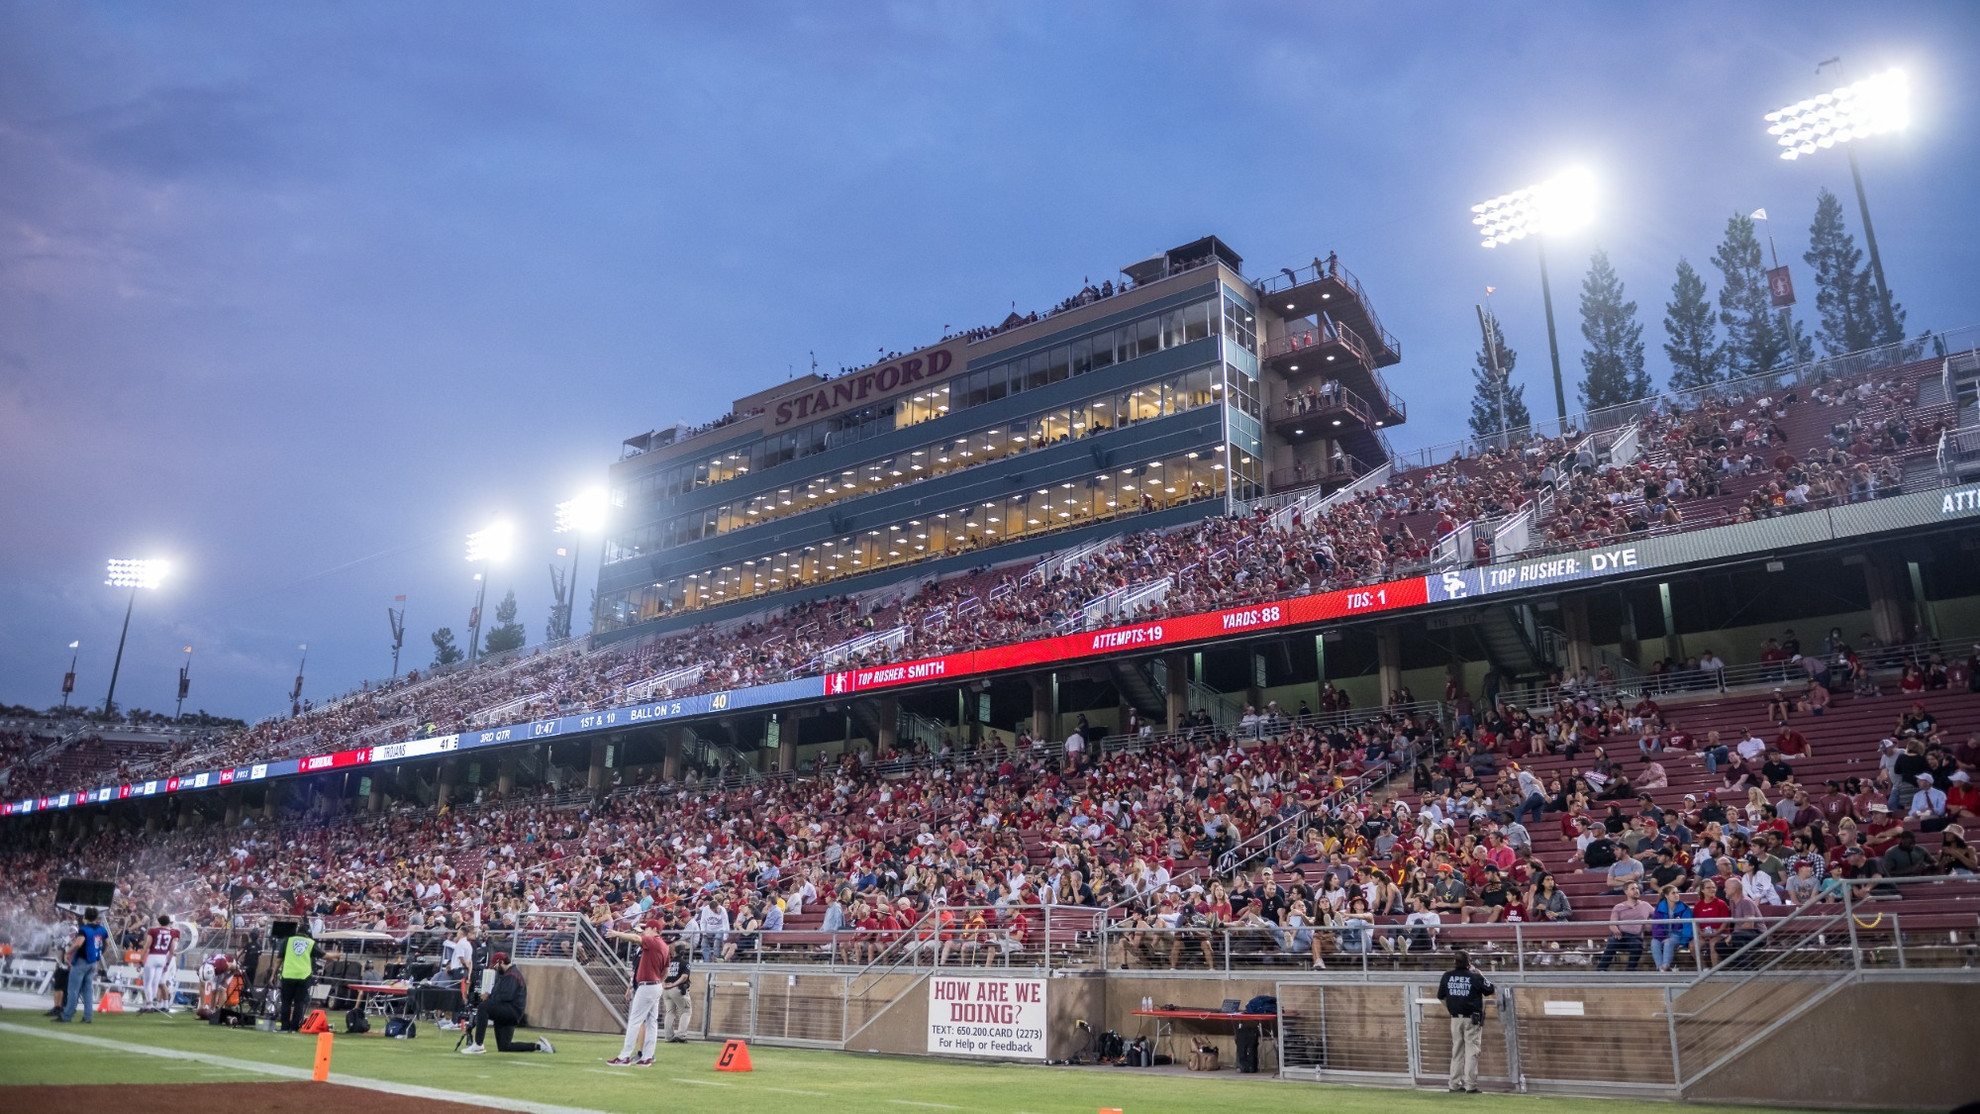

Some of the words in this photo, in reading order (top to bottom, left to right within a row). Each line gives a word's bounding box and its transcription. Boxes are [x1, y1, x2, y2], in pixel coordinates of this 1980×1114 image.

[775, 349, 952, 425] STANFORD
[1490, 568, 1516, 587] TOP
[1520, 560, 1580, 584] RUSHER:
[1591, 548, 1637, 571] DYE
[1347, 592, 1374, 610] TDS:
[1377, 590, 1386, 605] 1
[858, 671, 874, 686] TOP
[874, 668, 906, 684] RUSHER:
[907, 661, 945, 679] SMITH
[712, 694, 727, 709] 40
[630, 707, 651, 721] BALL
[652, 705, 668, 718] ON
[671, 703, 681, 714] 25
[535, 721, 555, 735] 0:47
[580, 717, 594, 729] 1ST
[597, 715, 603, 726] &
[606, 713, 616, 724] 10
[480, 731, 494, 743] 3RD
[496, 729, 511, 741] QTR
[356, 751, 365, 763] 14
[384, 744, 406, 759] TROJANS
[440, 739, 449, 750] 41
[155, 934, 172, 950] 13
[934, 981, 971, 1001] HOW
[977, 982, 1008, 1002] ARE
[1015, 982, 1041, 1003] WE
[1447, 982, 1472, 990] SECURITY
[950, 1002, 1022, 1024] DOING?
[932, 1025, 955, 1035] TEXT:
[956, 1026, 1013, 1038] 650.200.CARD
[1016, 1028, 1043, 1040] (2273)
[939, 1038, 952, 1048] For
[955, 1039, 975, 1051] Help
[979, 1041, 988, 1050] or
[991, 1040, 1033, 1052] Feedback
[719, 1043, 738, 1066] G
